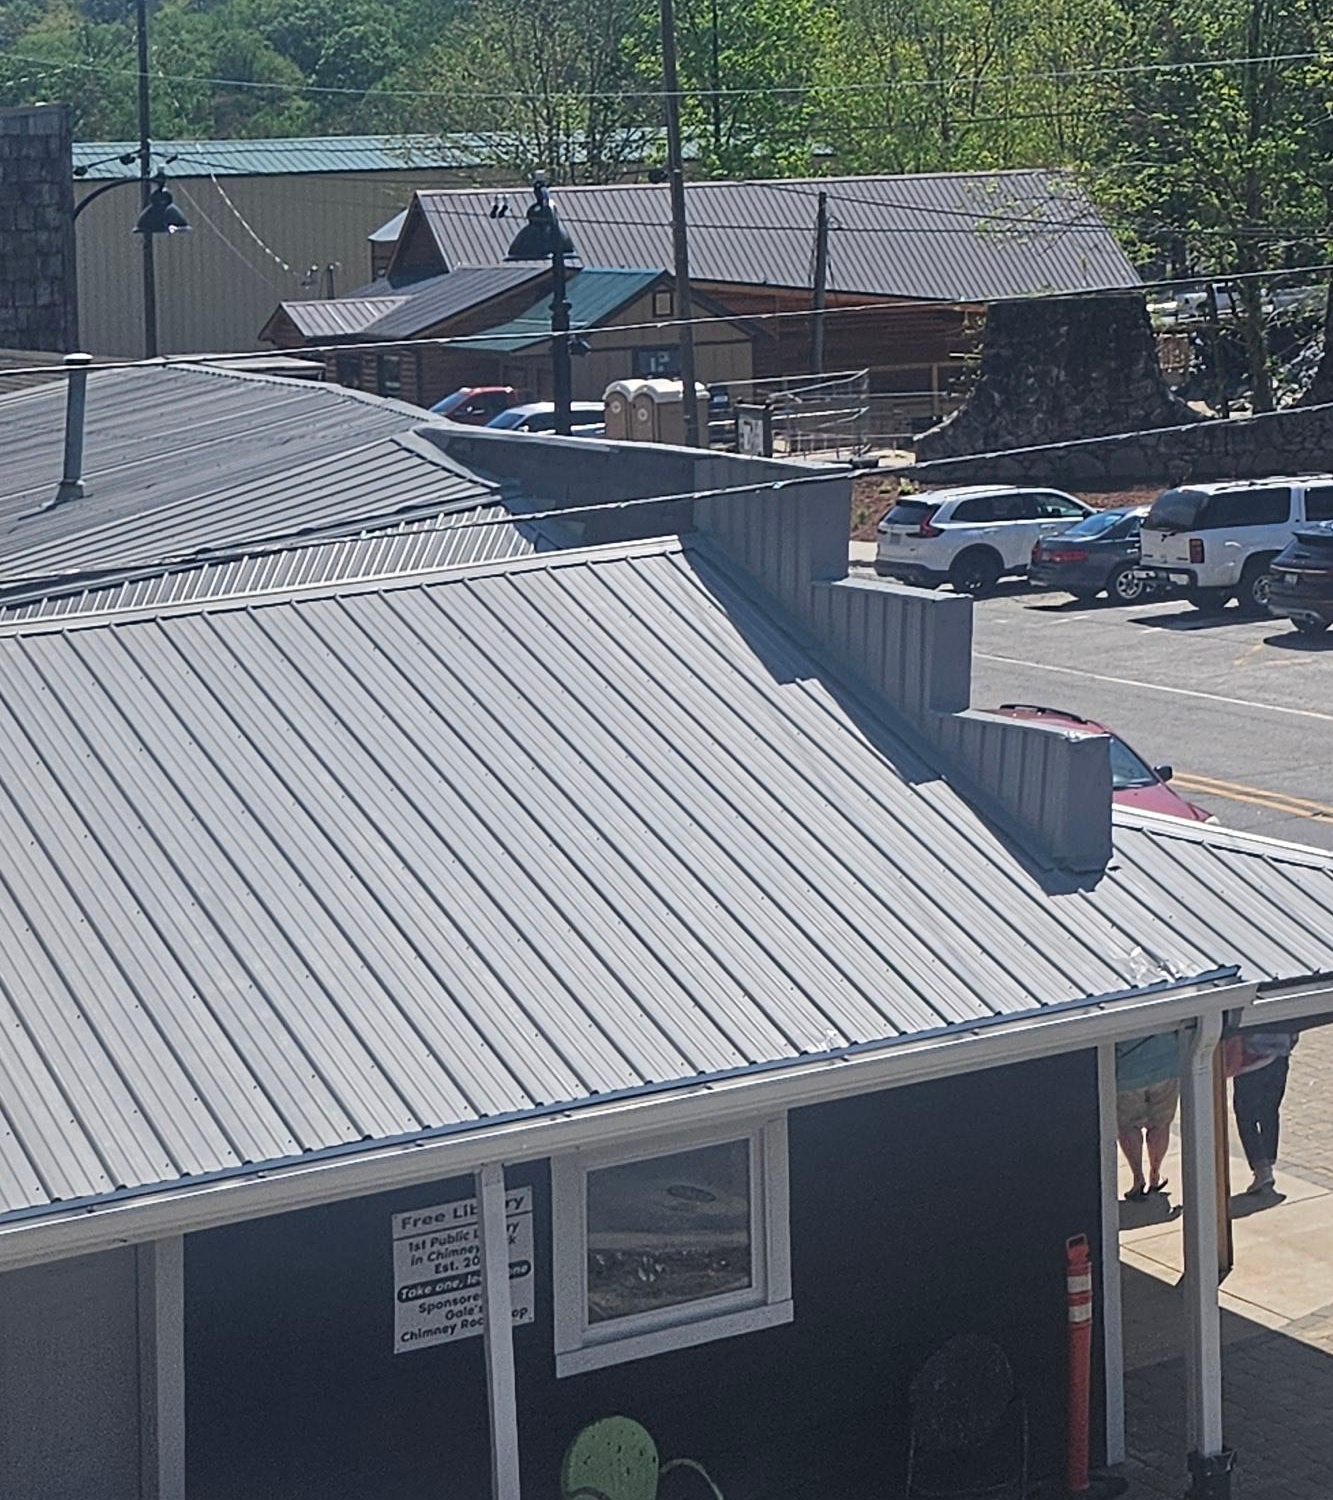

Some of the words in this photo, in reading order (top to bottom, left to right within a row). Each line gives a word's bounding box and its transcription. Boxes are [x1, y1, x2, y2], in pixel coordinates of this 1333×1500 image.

[401, 1212, 446, 1230] Free
[452, 1196, 524, 1220] Libry
[408, 1239, 426, 1253] 1st
[430, 1229, 470, 1249] Public
[410, 1254, 424, 1268] in
[434, 1261, 459, 1275] Est.
[400, 1285, 432, 1300] Take
[435, 1278, 463, 1293] one,
[509, 1264, 532, 1275] ne
[418, 1292, 480, 1315] Sponsore
[400, 1322, 457, 1343] Chimney
[461, 1317, 484, 1330] Roc
